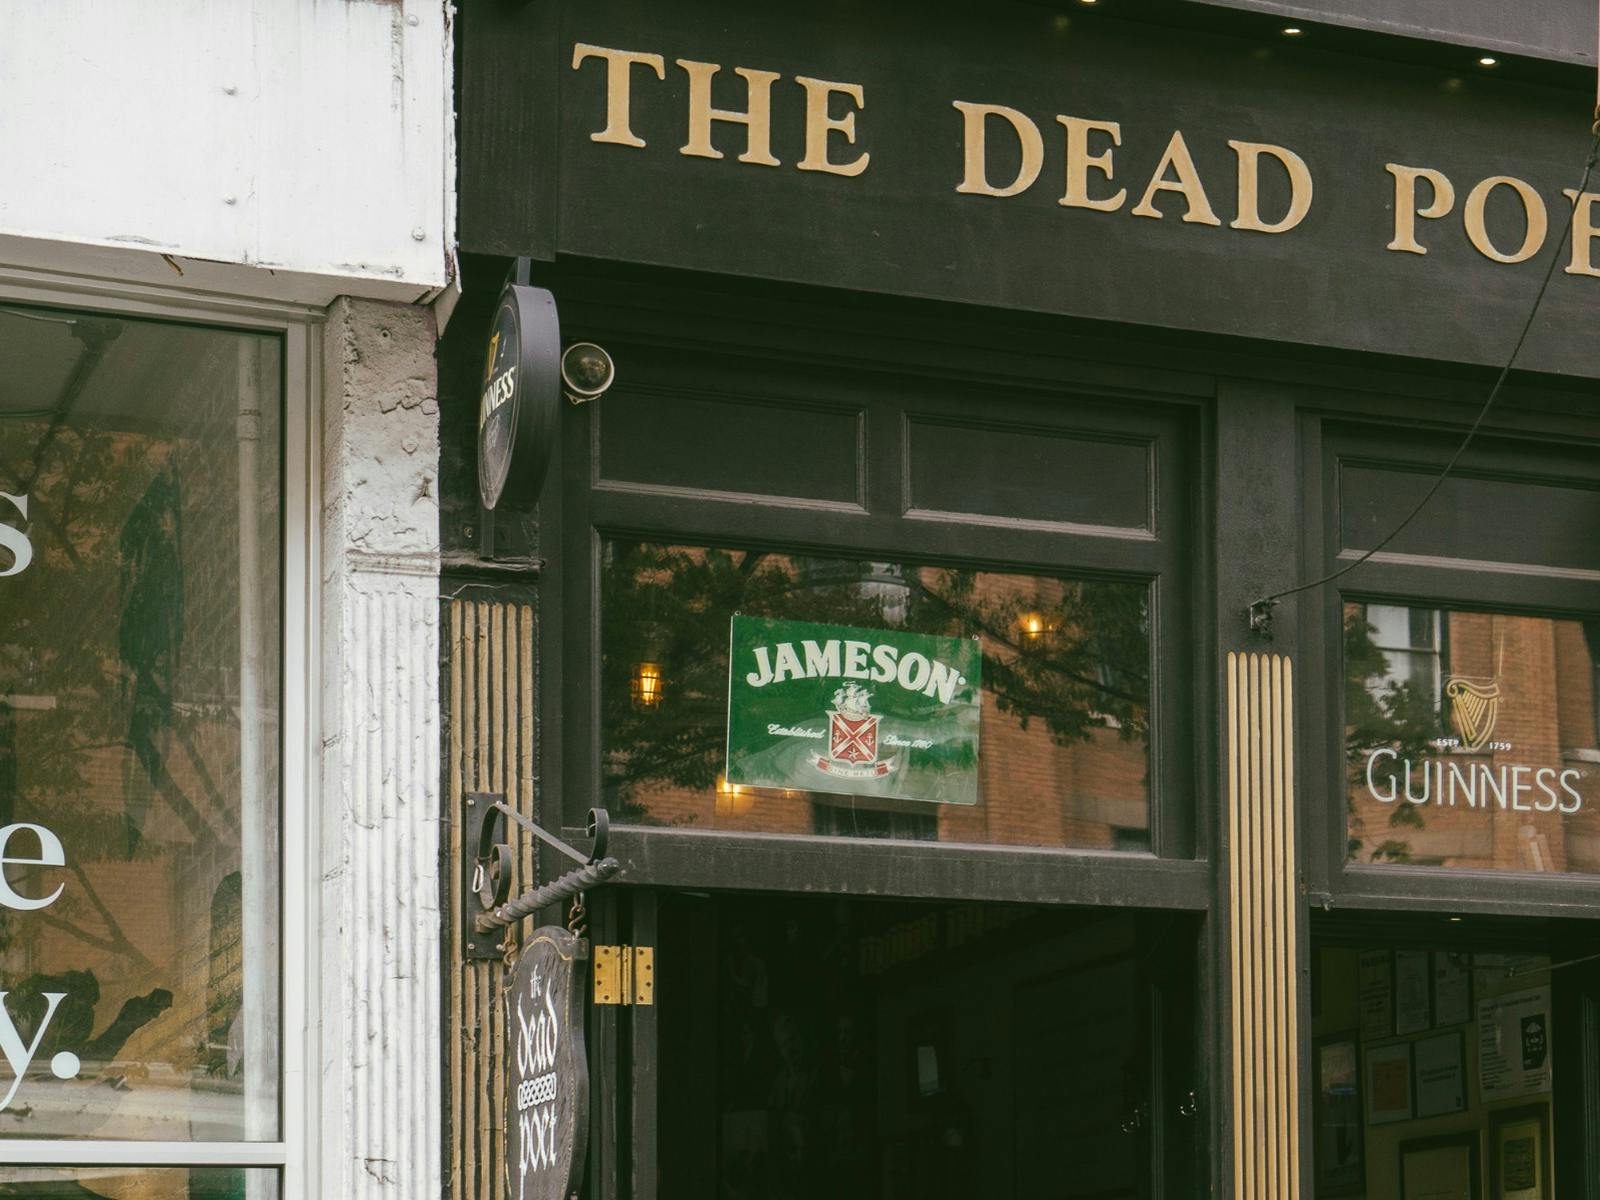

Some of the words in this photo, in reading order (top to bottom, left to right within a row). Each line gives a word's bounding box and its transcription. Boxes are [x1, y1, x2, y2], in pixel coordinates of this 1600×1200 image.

[571, 42, 870, 177] THE
[952, 99, 1313, 234] DEAD
[746, 640, 961, 704] JAMESON
[1489, 742, 1512, 751] 1759
[1366, 748, 1582, 813] GUINNESS
[517, 977, 558, 1080] dead
